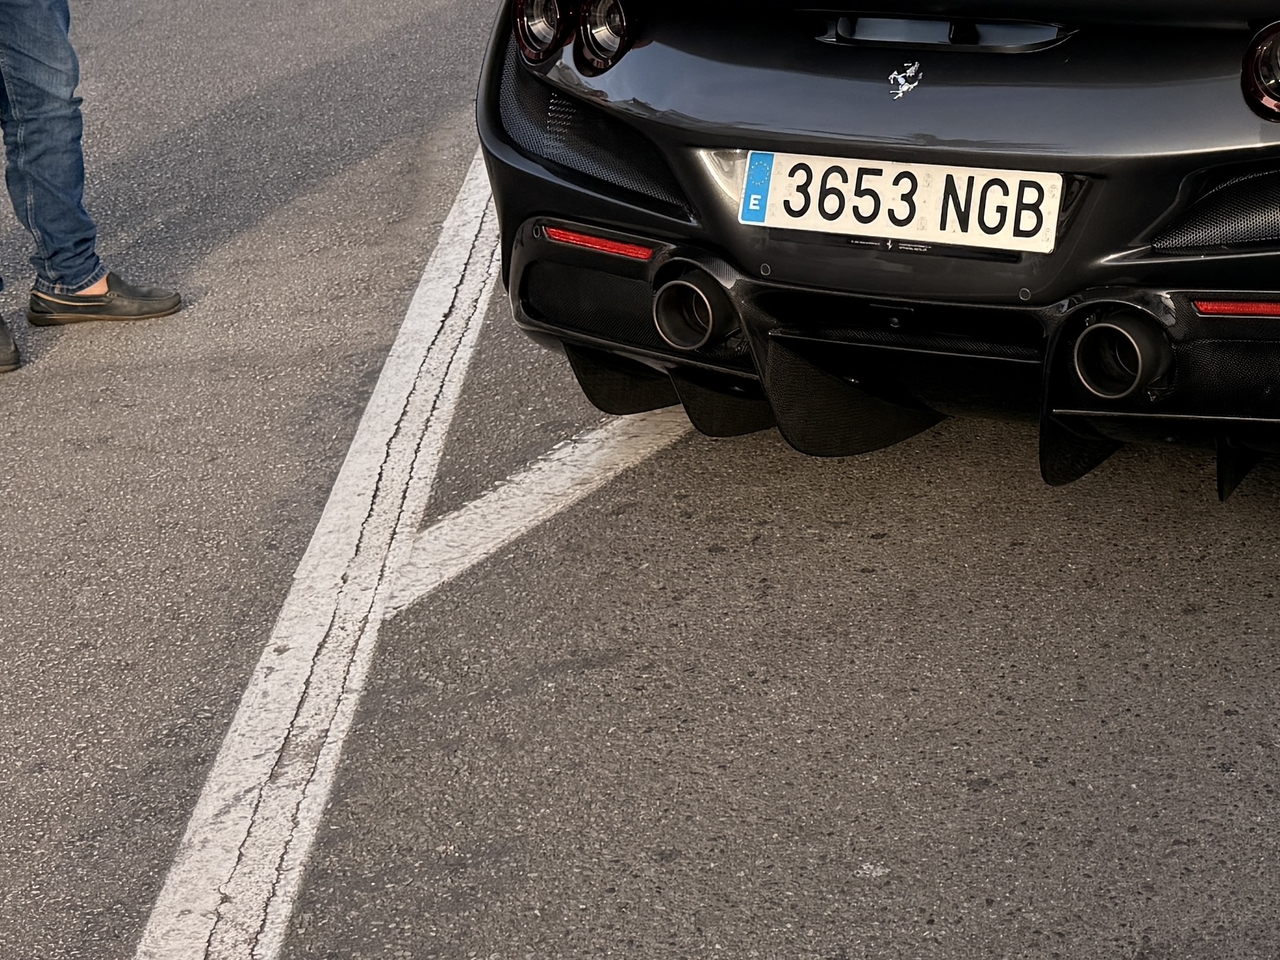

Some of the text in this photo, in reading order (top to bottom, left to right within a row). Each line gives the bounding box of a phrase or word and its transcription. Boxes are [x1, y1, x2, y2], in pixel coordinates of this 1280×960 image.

[749, 195, 761, 210] E
[783, 163, 1045, 238] 3653 NGB
